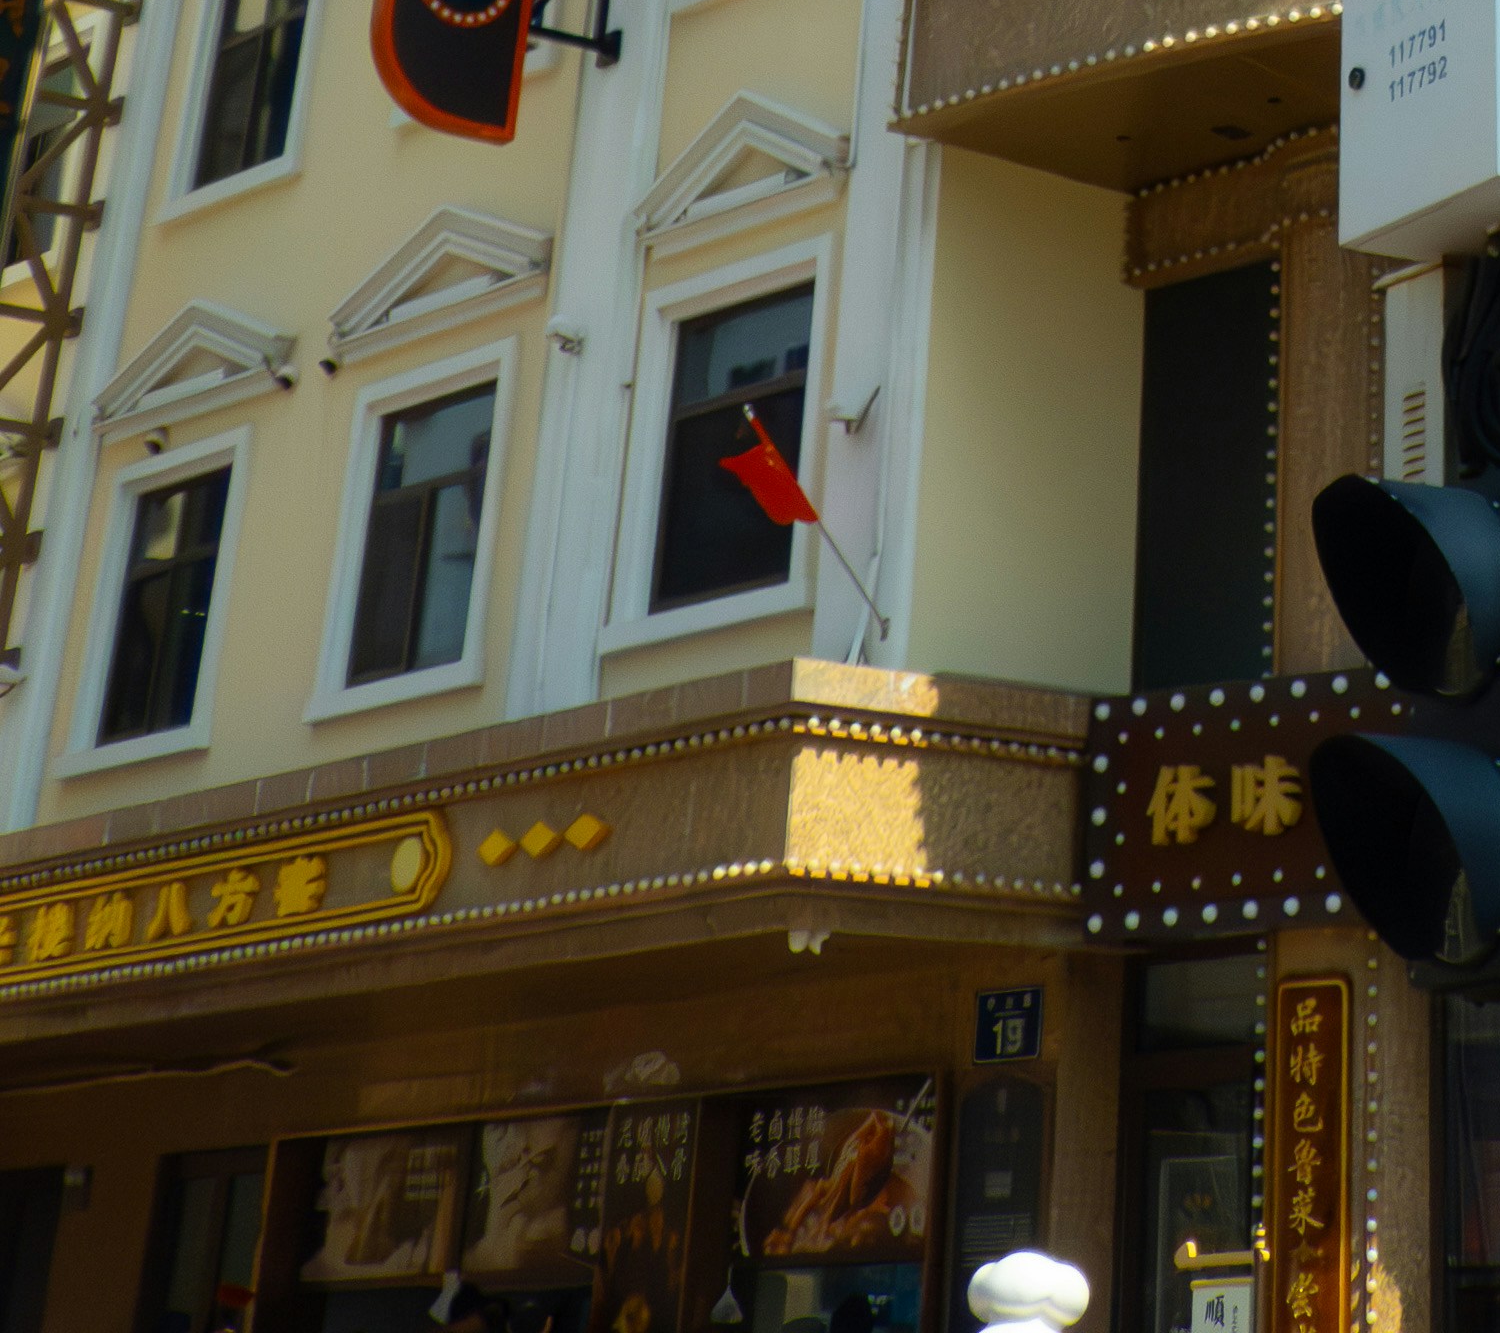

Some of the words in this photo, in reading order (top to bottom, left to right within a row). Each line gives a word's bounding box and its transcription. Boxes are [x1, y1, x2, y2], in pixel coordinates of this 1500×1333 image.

[1389, 19, 1447, 69] 117791
[1389, 55, 1448, 102] 117792
[1146, 754, 1304, 847] 体味
